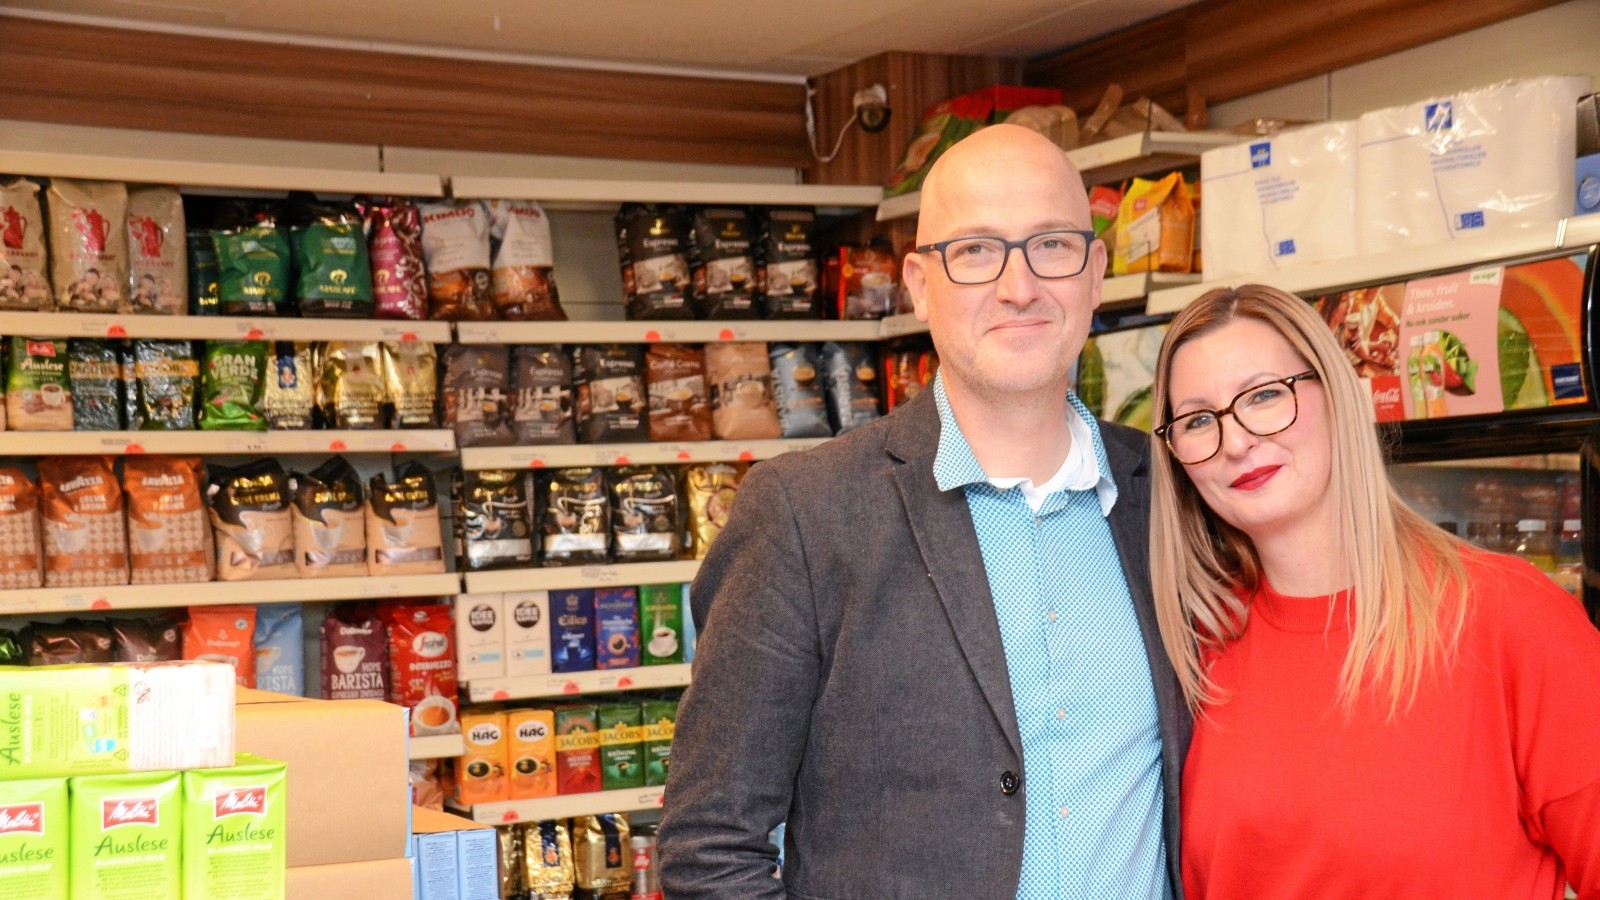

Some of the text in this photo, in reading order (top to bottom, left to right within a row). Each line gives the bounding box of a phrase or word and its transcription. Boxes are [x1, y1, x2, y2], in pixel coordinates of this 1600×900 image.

[1410, 281, 1459, 300] Thee, fruit
[1406, 299, 1455, 315] & kruiden.
[1428, 314, 1449, 325] zonder
[20, 358, 64, 371] Auslese
[213, 354, 256, 368] GRAN
[210, 365, 258, 380] VERDE
[60, 475, 104, 492] LAVAZZA
[142, 474, 185, 486] LAVAZZA
[257, 675, 297, 691] RISTA
[331, 673, 384, 691] BARISTA
[1, 693, 21, 765] Auslese
[472, 730, 499, 741] HAG
[519, 727, 545, 738] HAG
[603, 729, 641, 741] JACOBS
[648, 726, 674, 737] JACO
[561, 735, 599, 748] JACOBS
[219, 791, 259, 810] Melitta
[107, 800, 152, 822] Melitta
[206, 822, 275, 845] Auslese
[94, 832, 168, 857] Auslese
[0, 842, 54, 864] uslese
